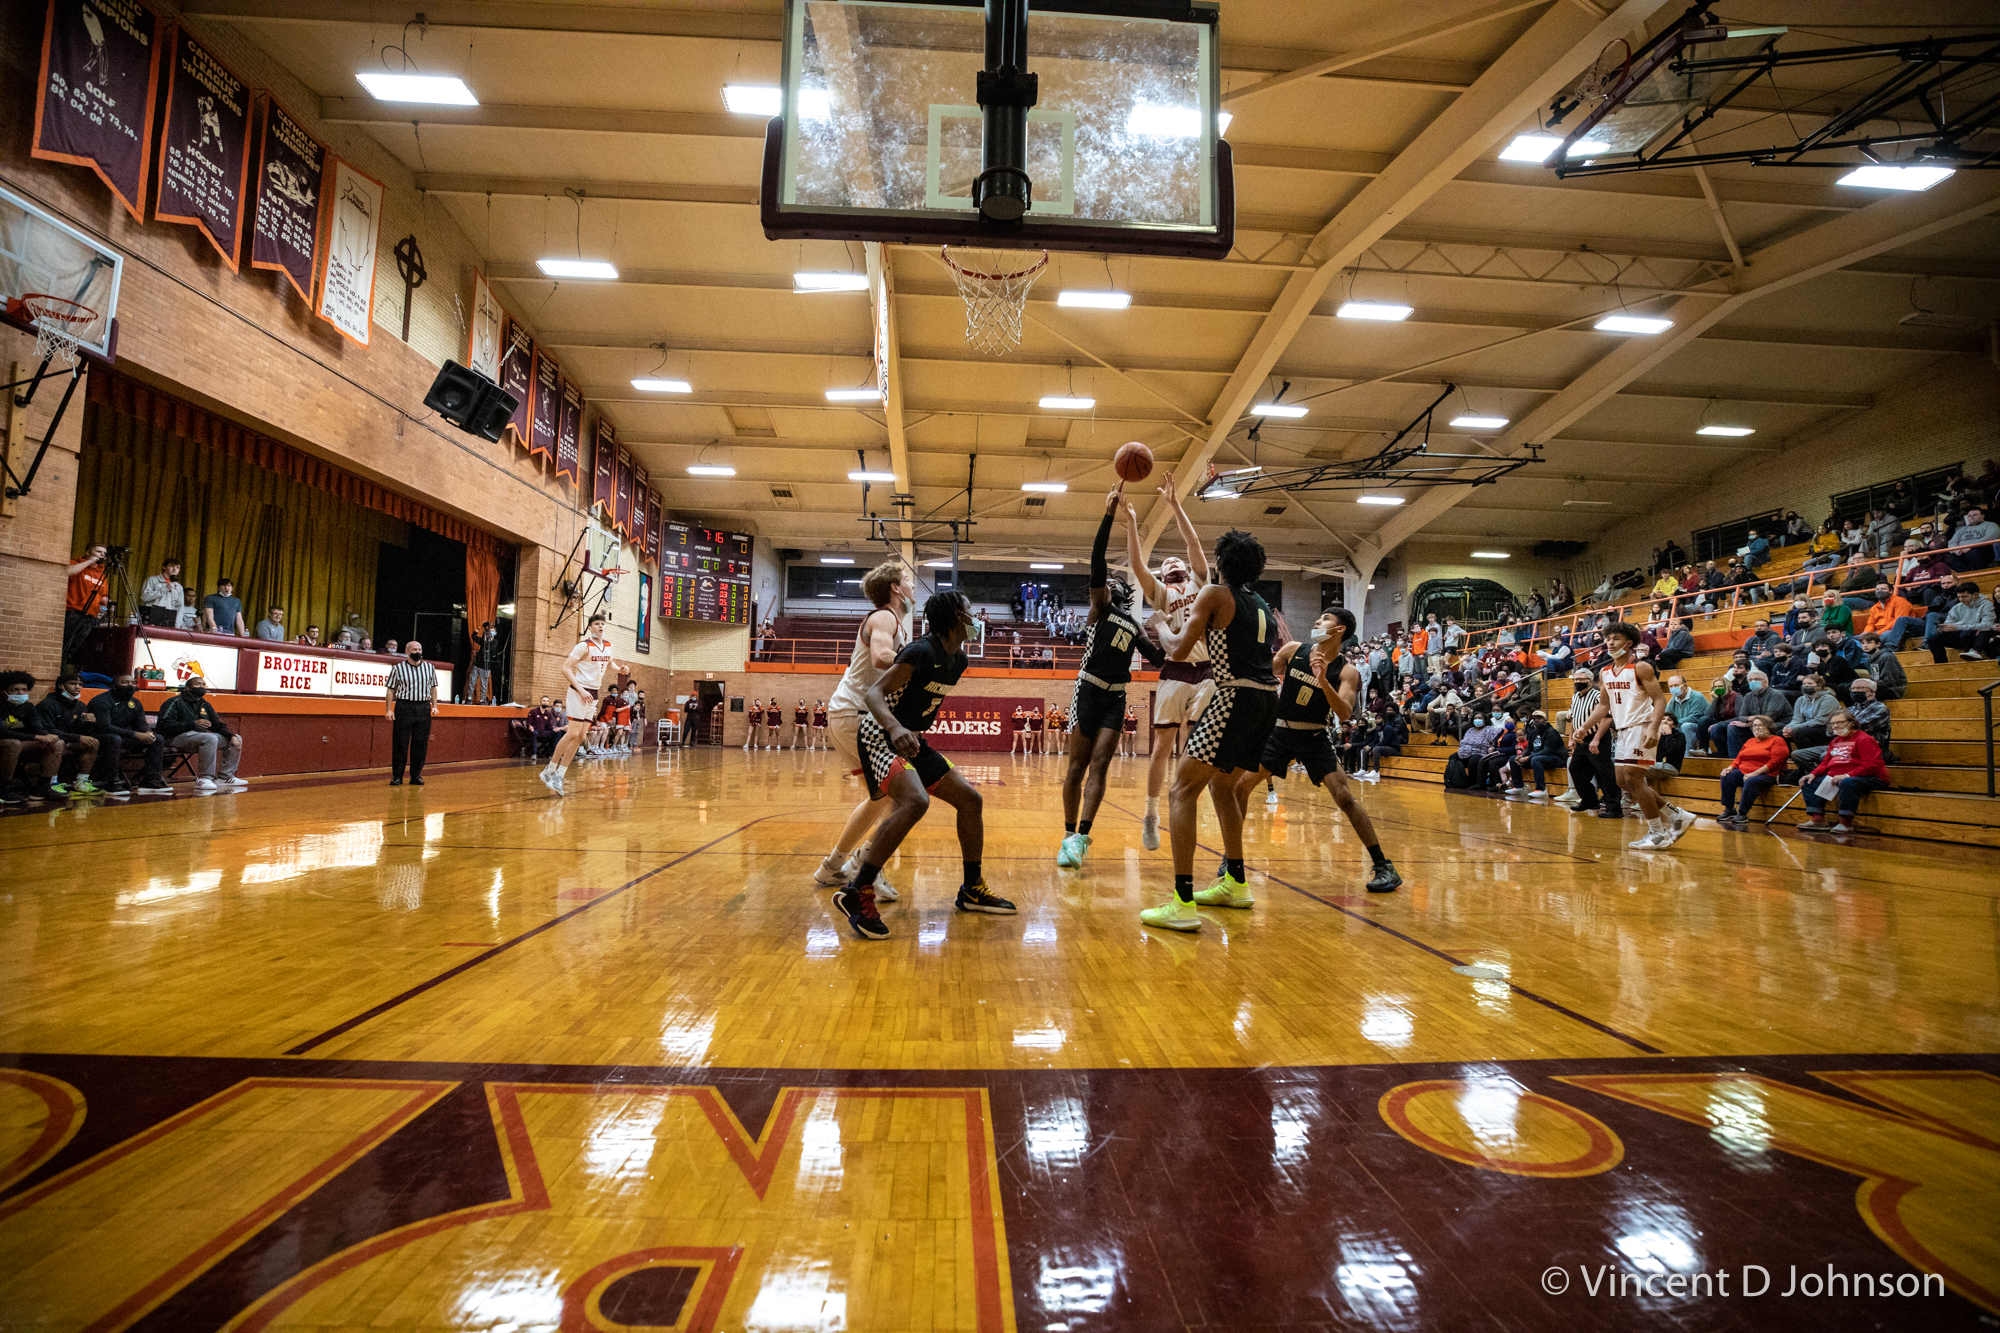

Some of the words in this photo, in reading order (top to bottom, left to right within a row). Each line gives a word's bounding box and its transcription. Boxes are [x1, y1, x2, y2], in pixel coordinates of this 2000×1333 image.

[188, 40, 240, 92] CATHOLIC
[192, 56, 234, 98] LEAGUE
[86, 81, 116, 107] GOLF
[182, 58, 242, 116] CHAMPIONS
[70, 98, 85, 115] 04,
[92, 102, 105, 118] 71,
[109, 113, 122, 130] 73,
[124, 125, 138, 140] 74,
[278, 109, 318, 152] CATHOLIC
[281, 122, 315, 158] LEAGUE
[187, 145, 224, 177] HOCKEY
[167, 176, 178, 192] 70,
[210, 176, 222, 190] 72,
[210, 188, 220, 200] 01,
[670, 524, 689, 532] GUEST
[680, 533, 686, 544] 3
[703, 530, 724, 544] 7:16
[716, 546, 720, 554] 1
[740, 542, 748, 554] 0
[682, 557, 688, 566] 5
[704, 560, 708, 568] 0
[714, 562, 719, 570] 0
[728, 564, 734, 572] 5
[742, 566, 748, 574] 0
[1258, 608, 1266, 644] 1
[1110, 628, 1132, 652] 13
[264, 656, 328, 674] BROTHER
[280, 675, 311, 690] RICE
[1296, 686, 1314, 706] 0
[926, 720, 1001, 735] SADERS
